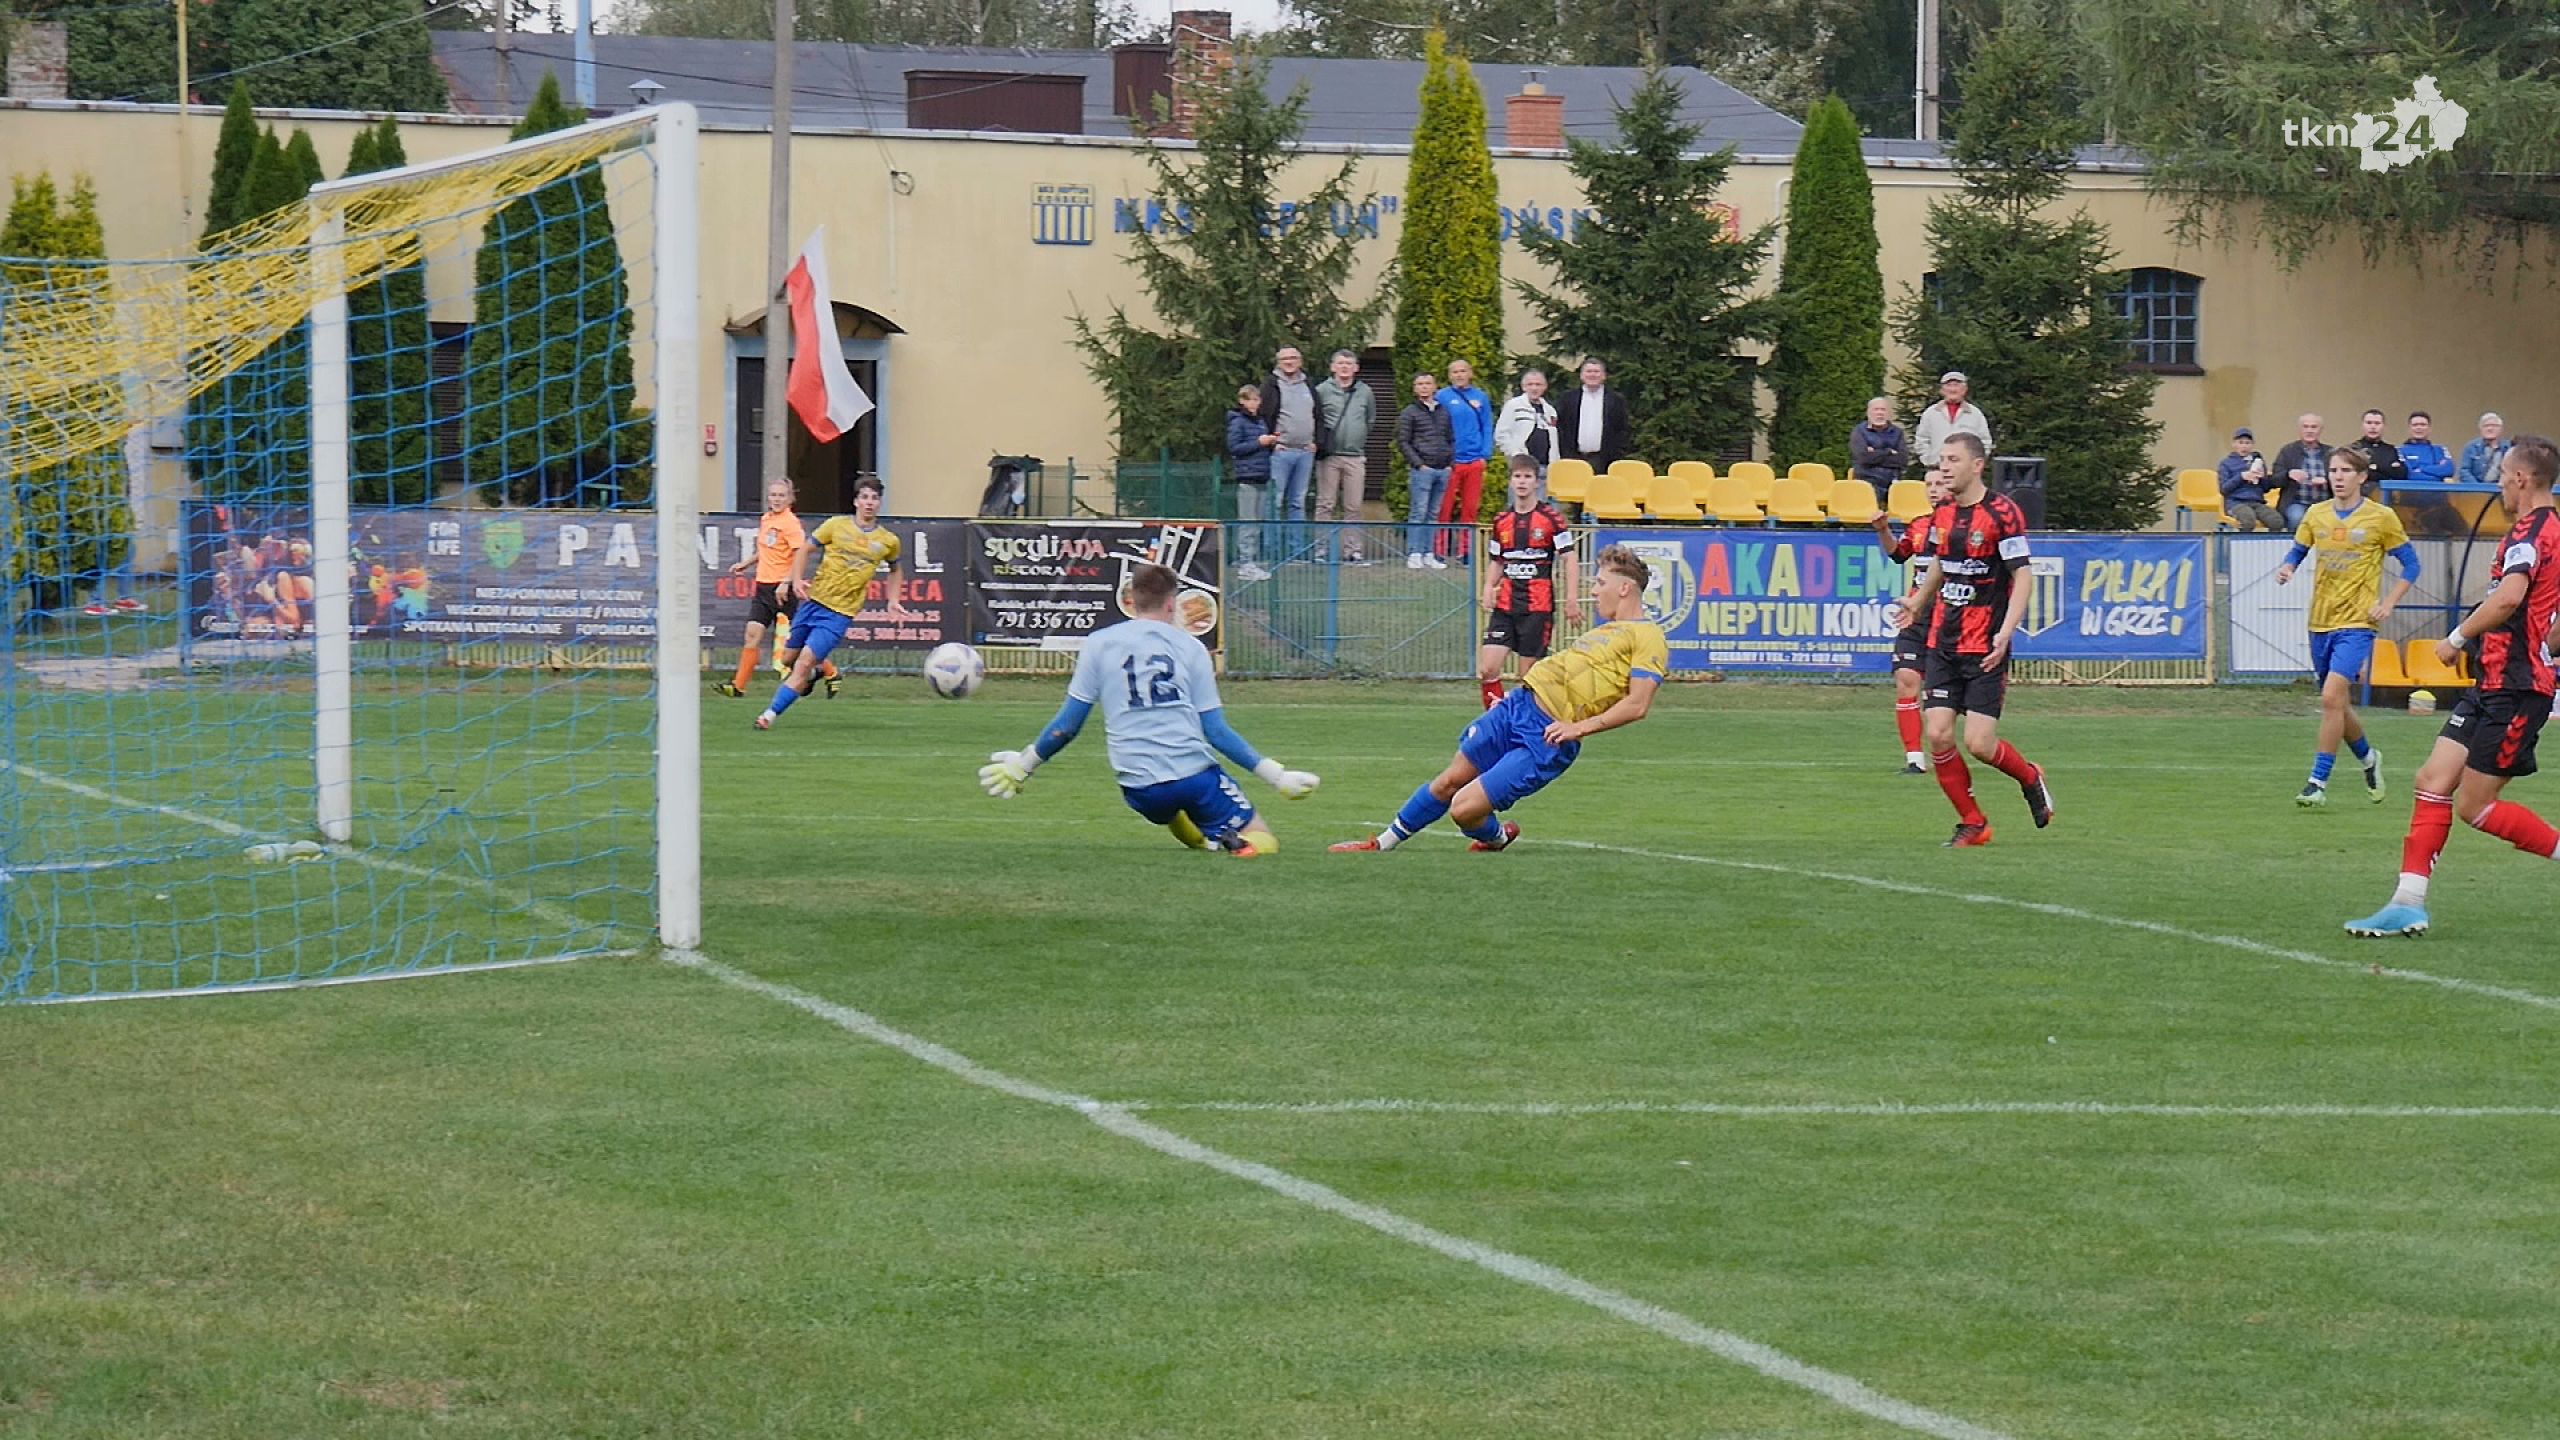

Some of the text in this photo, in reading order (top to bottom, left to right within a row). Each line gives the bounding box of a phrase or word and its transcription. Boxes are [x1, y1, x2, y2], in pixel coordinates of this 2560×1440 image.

[429, 522, 460, 537] FOR
[428, 540, 460, 556] LIFE
[996, 611, 1096, 629] 791 356 765
[1698, 601, 1817, 637] NEPTUN
[1822, 598, 1901, 637] KOŃS
[2081, 605, 2170, 636] W GRZE
[1122, 654, 1181, 708] 12
